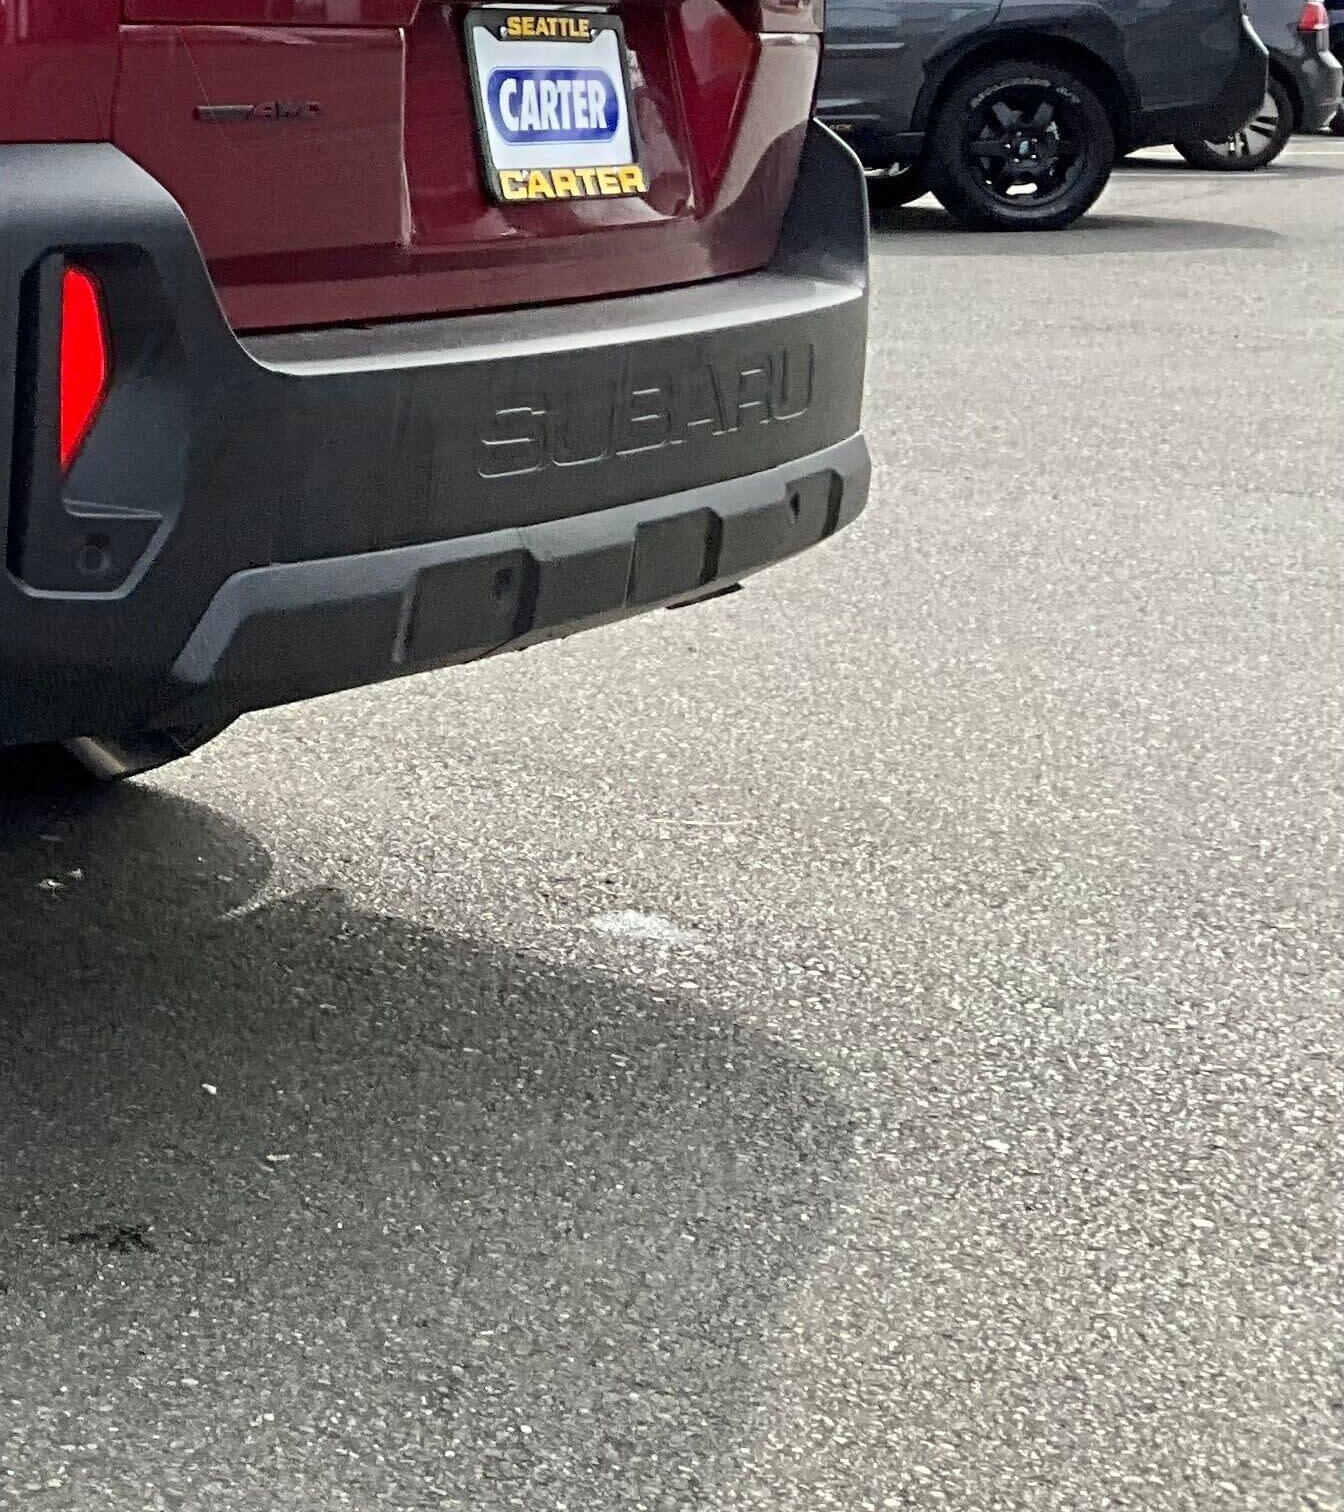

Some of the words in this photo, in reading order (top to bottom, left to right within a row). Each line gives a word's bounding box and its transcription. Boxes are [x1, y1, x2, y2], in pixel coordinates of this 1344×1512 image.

[505, 15, 591, 38] SEATTLE
[498, 77, 609, 133] CARTER
[498, 164, 648, 201] CARTER
[476, 343, 814, 479] SUBARU
